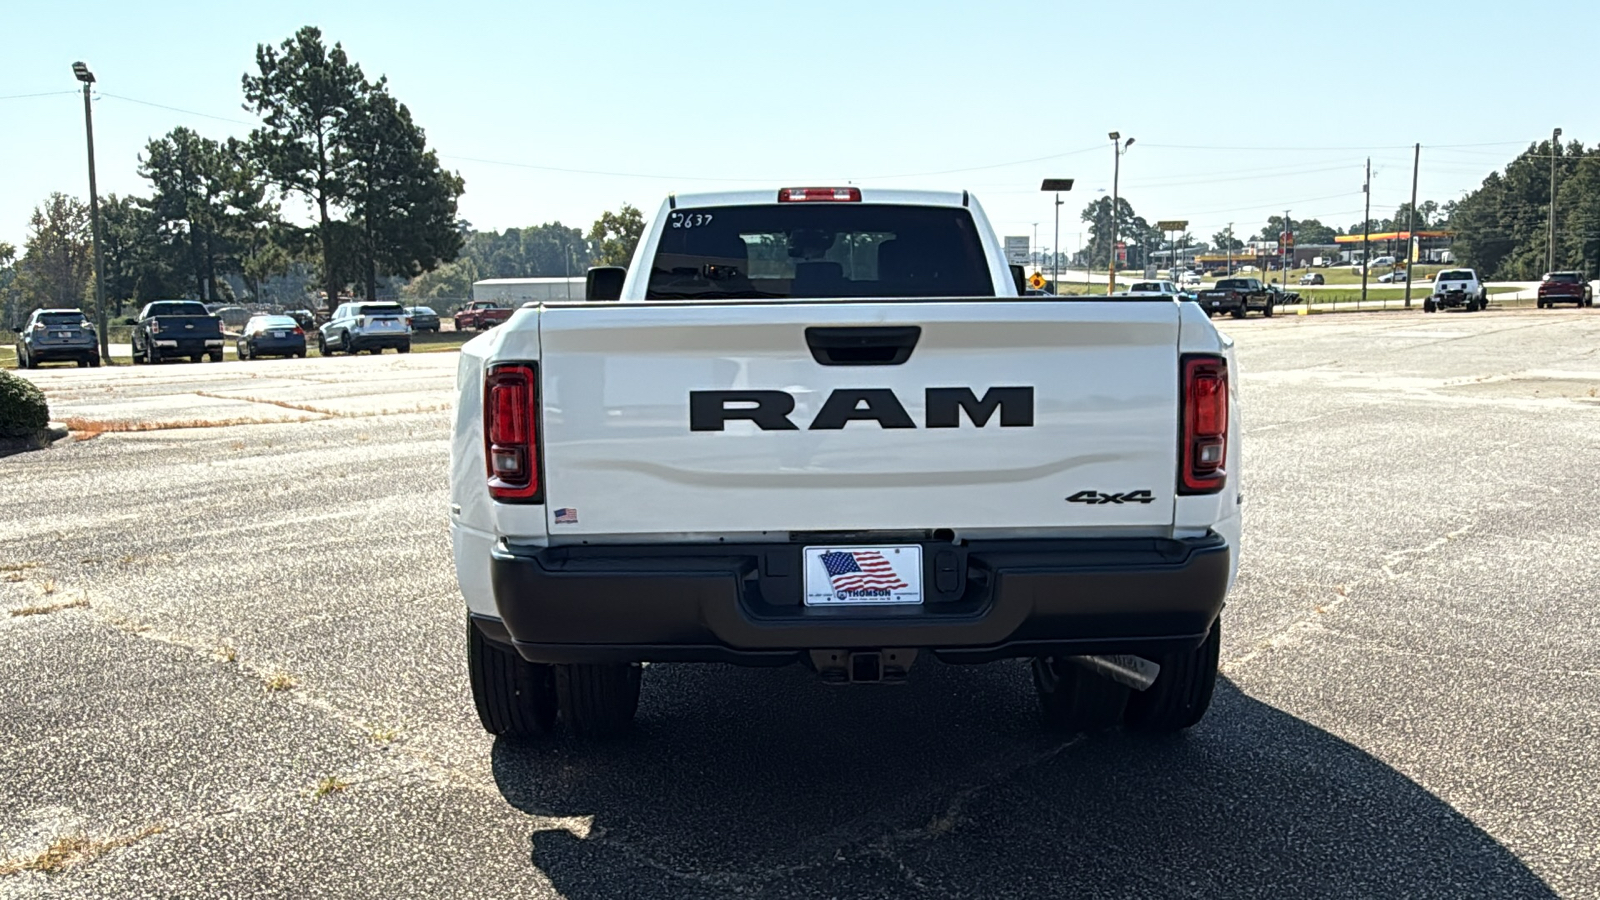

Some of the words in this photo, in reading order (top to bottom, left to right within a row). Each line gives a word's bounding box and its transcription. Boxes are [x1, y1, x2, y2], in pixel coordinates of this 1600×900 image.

[673, 213, 713, 228] 2637
[690, 386, 1034, 431] RAM
[1065, 490, 1156, 505] 4x4
